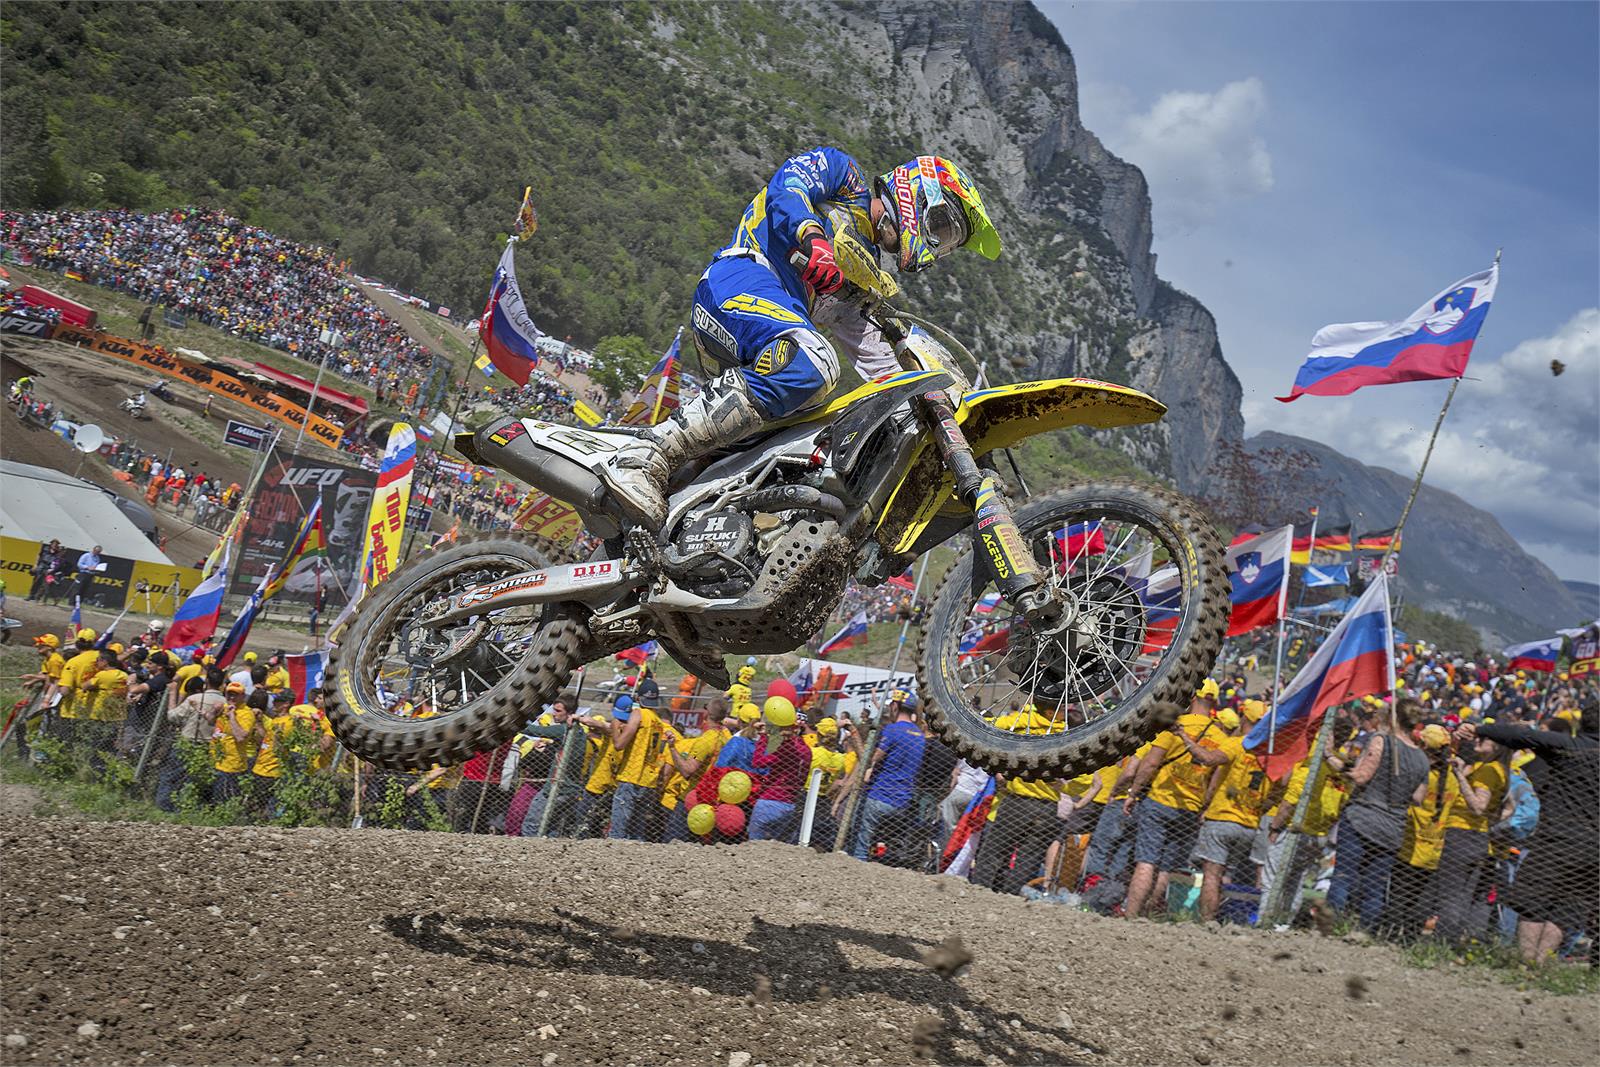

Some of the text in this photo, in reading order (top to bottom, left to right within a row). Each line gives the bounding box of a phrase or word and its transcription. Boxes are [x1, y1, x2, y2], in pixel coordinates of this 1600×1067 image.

[894, 167, 919, 237] SUOMY
[693, 303, 738, 356] SUZUKI
[98, 341, 135, 358] KTM
[139, 353, 176, 371] KTM
[180, 366, 213, 385] KTM
[216, 380, 248, 399] KTM
[251, 394, 282, 412] KTM
[311, 423, 341, 443] KTM
[1014, 383, 1043, 391] Bihr
[280, 468, 344, 485] UFO
[685, 531, 741, 543] SUZUKI
[981, 533, 1009, 579] ACERBIS
[458, 573, 547, 608] RENTHAL
